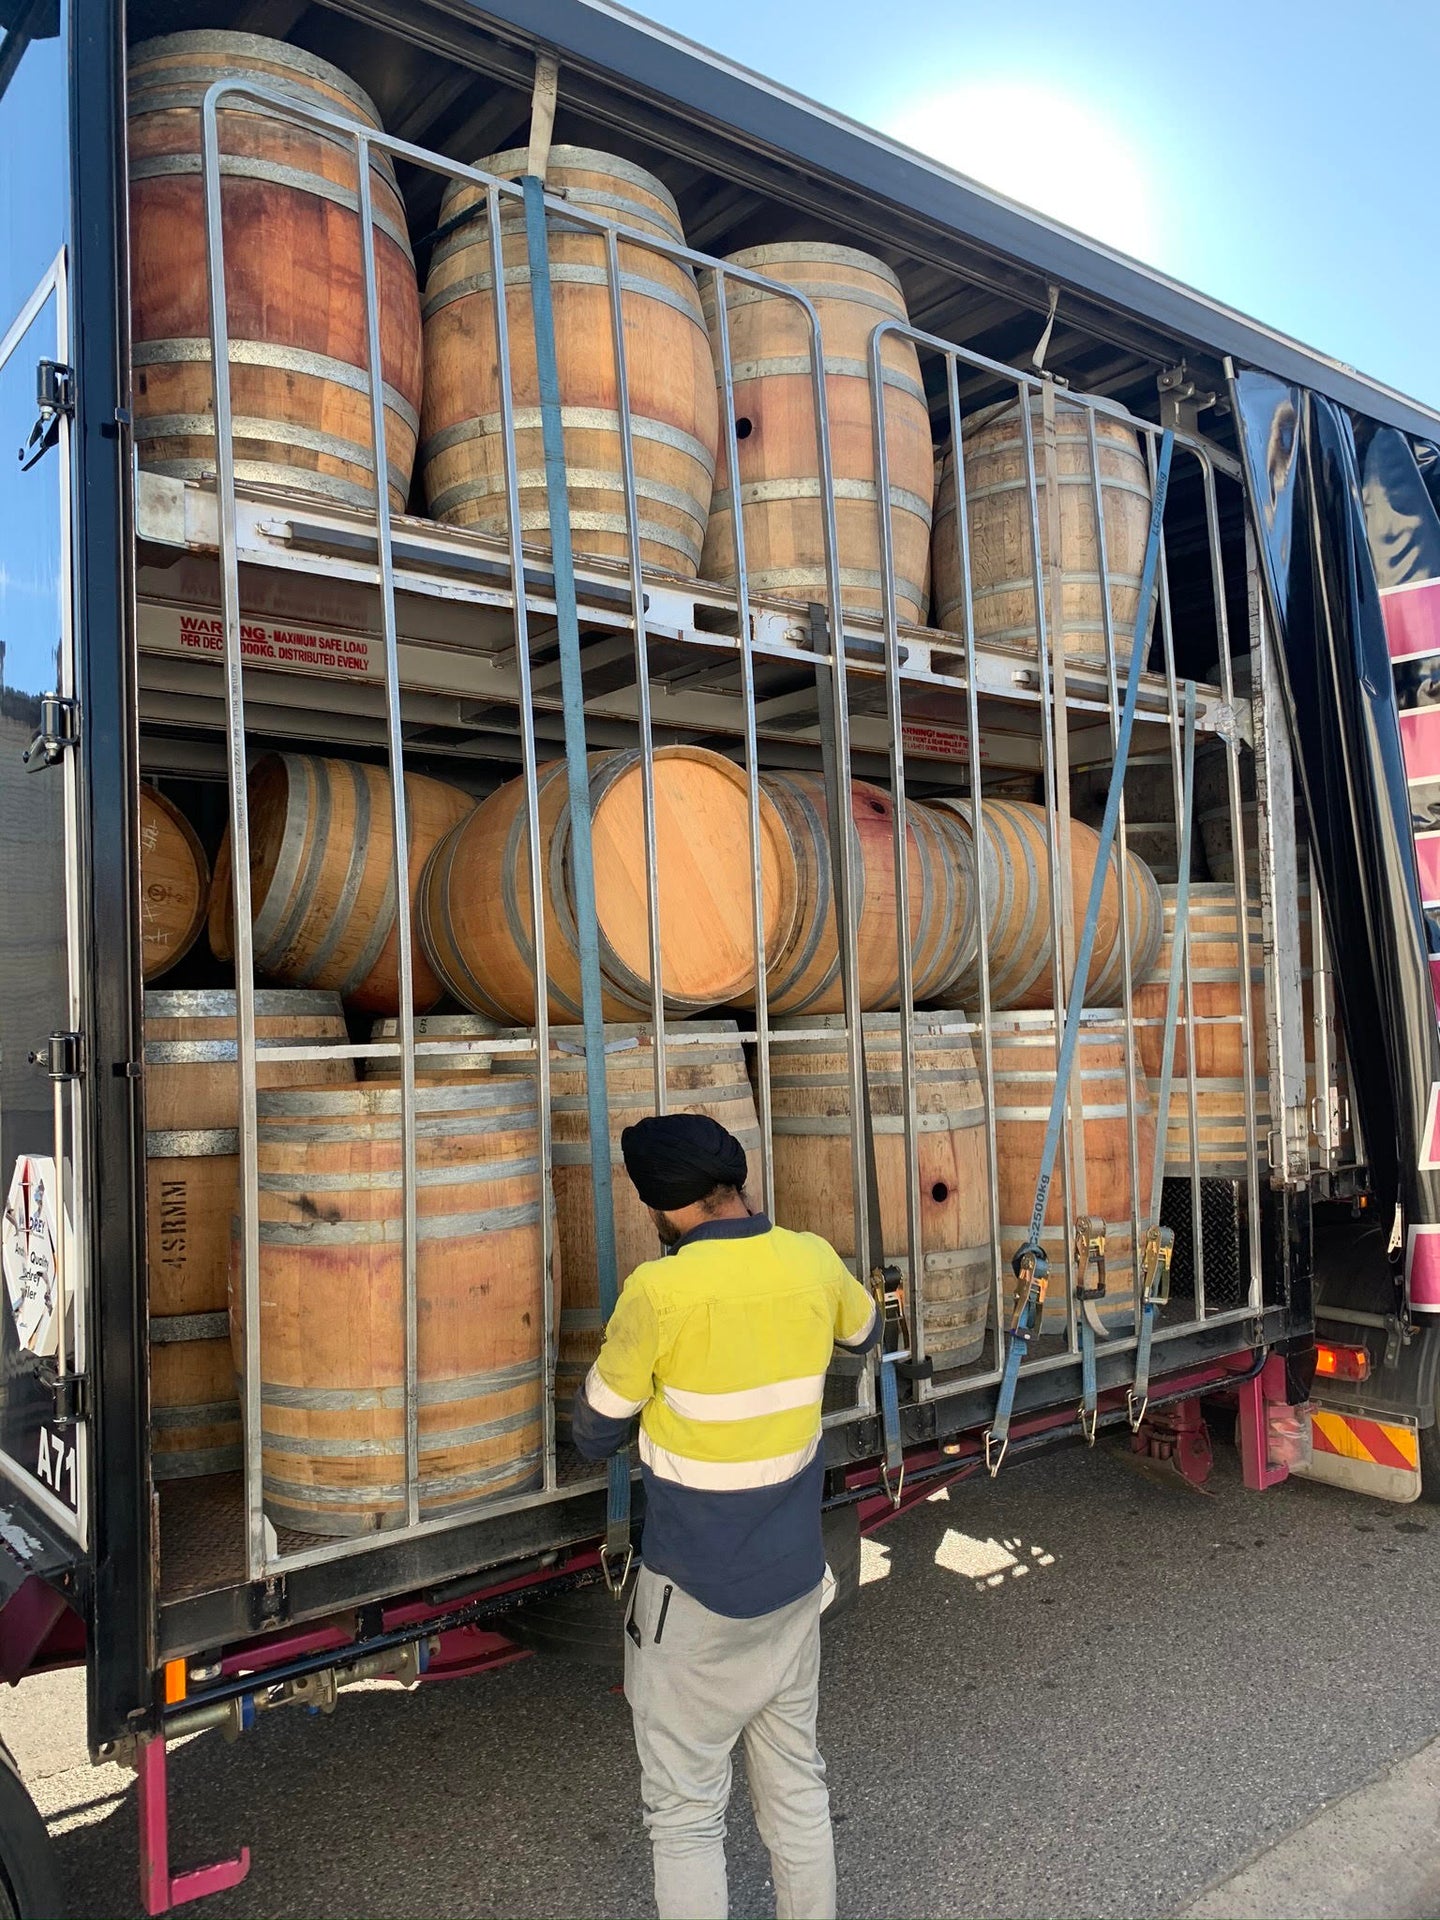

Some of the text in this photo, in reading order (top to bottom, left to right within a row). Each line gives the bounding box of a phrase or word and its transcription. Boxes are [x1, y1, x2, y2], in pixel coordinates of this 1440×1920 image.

[180, 616, 266, 641] WARNG
[273, 630, 317, 648] MAXIMUM
[318, 637, 342, 651] SAFE
[343, 641, 368, 655] LOAD
[180, 633, 370, 671] PER DEC 000KG. DISTRIBUTED EVENLY
[1030, 1174, 1051, 1245] C:2500kg
[37, 1426, 77, 1506] A71
